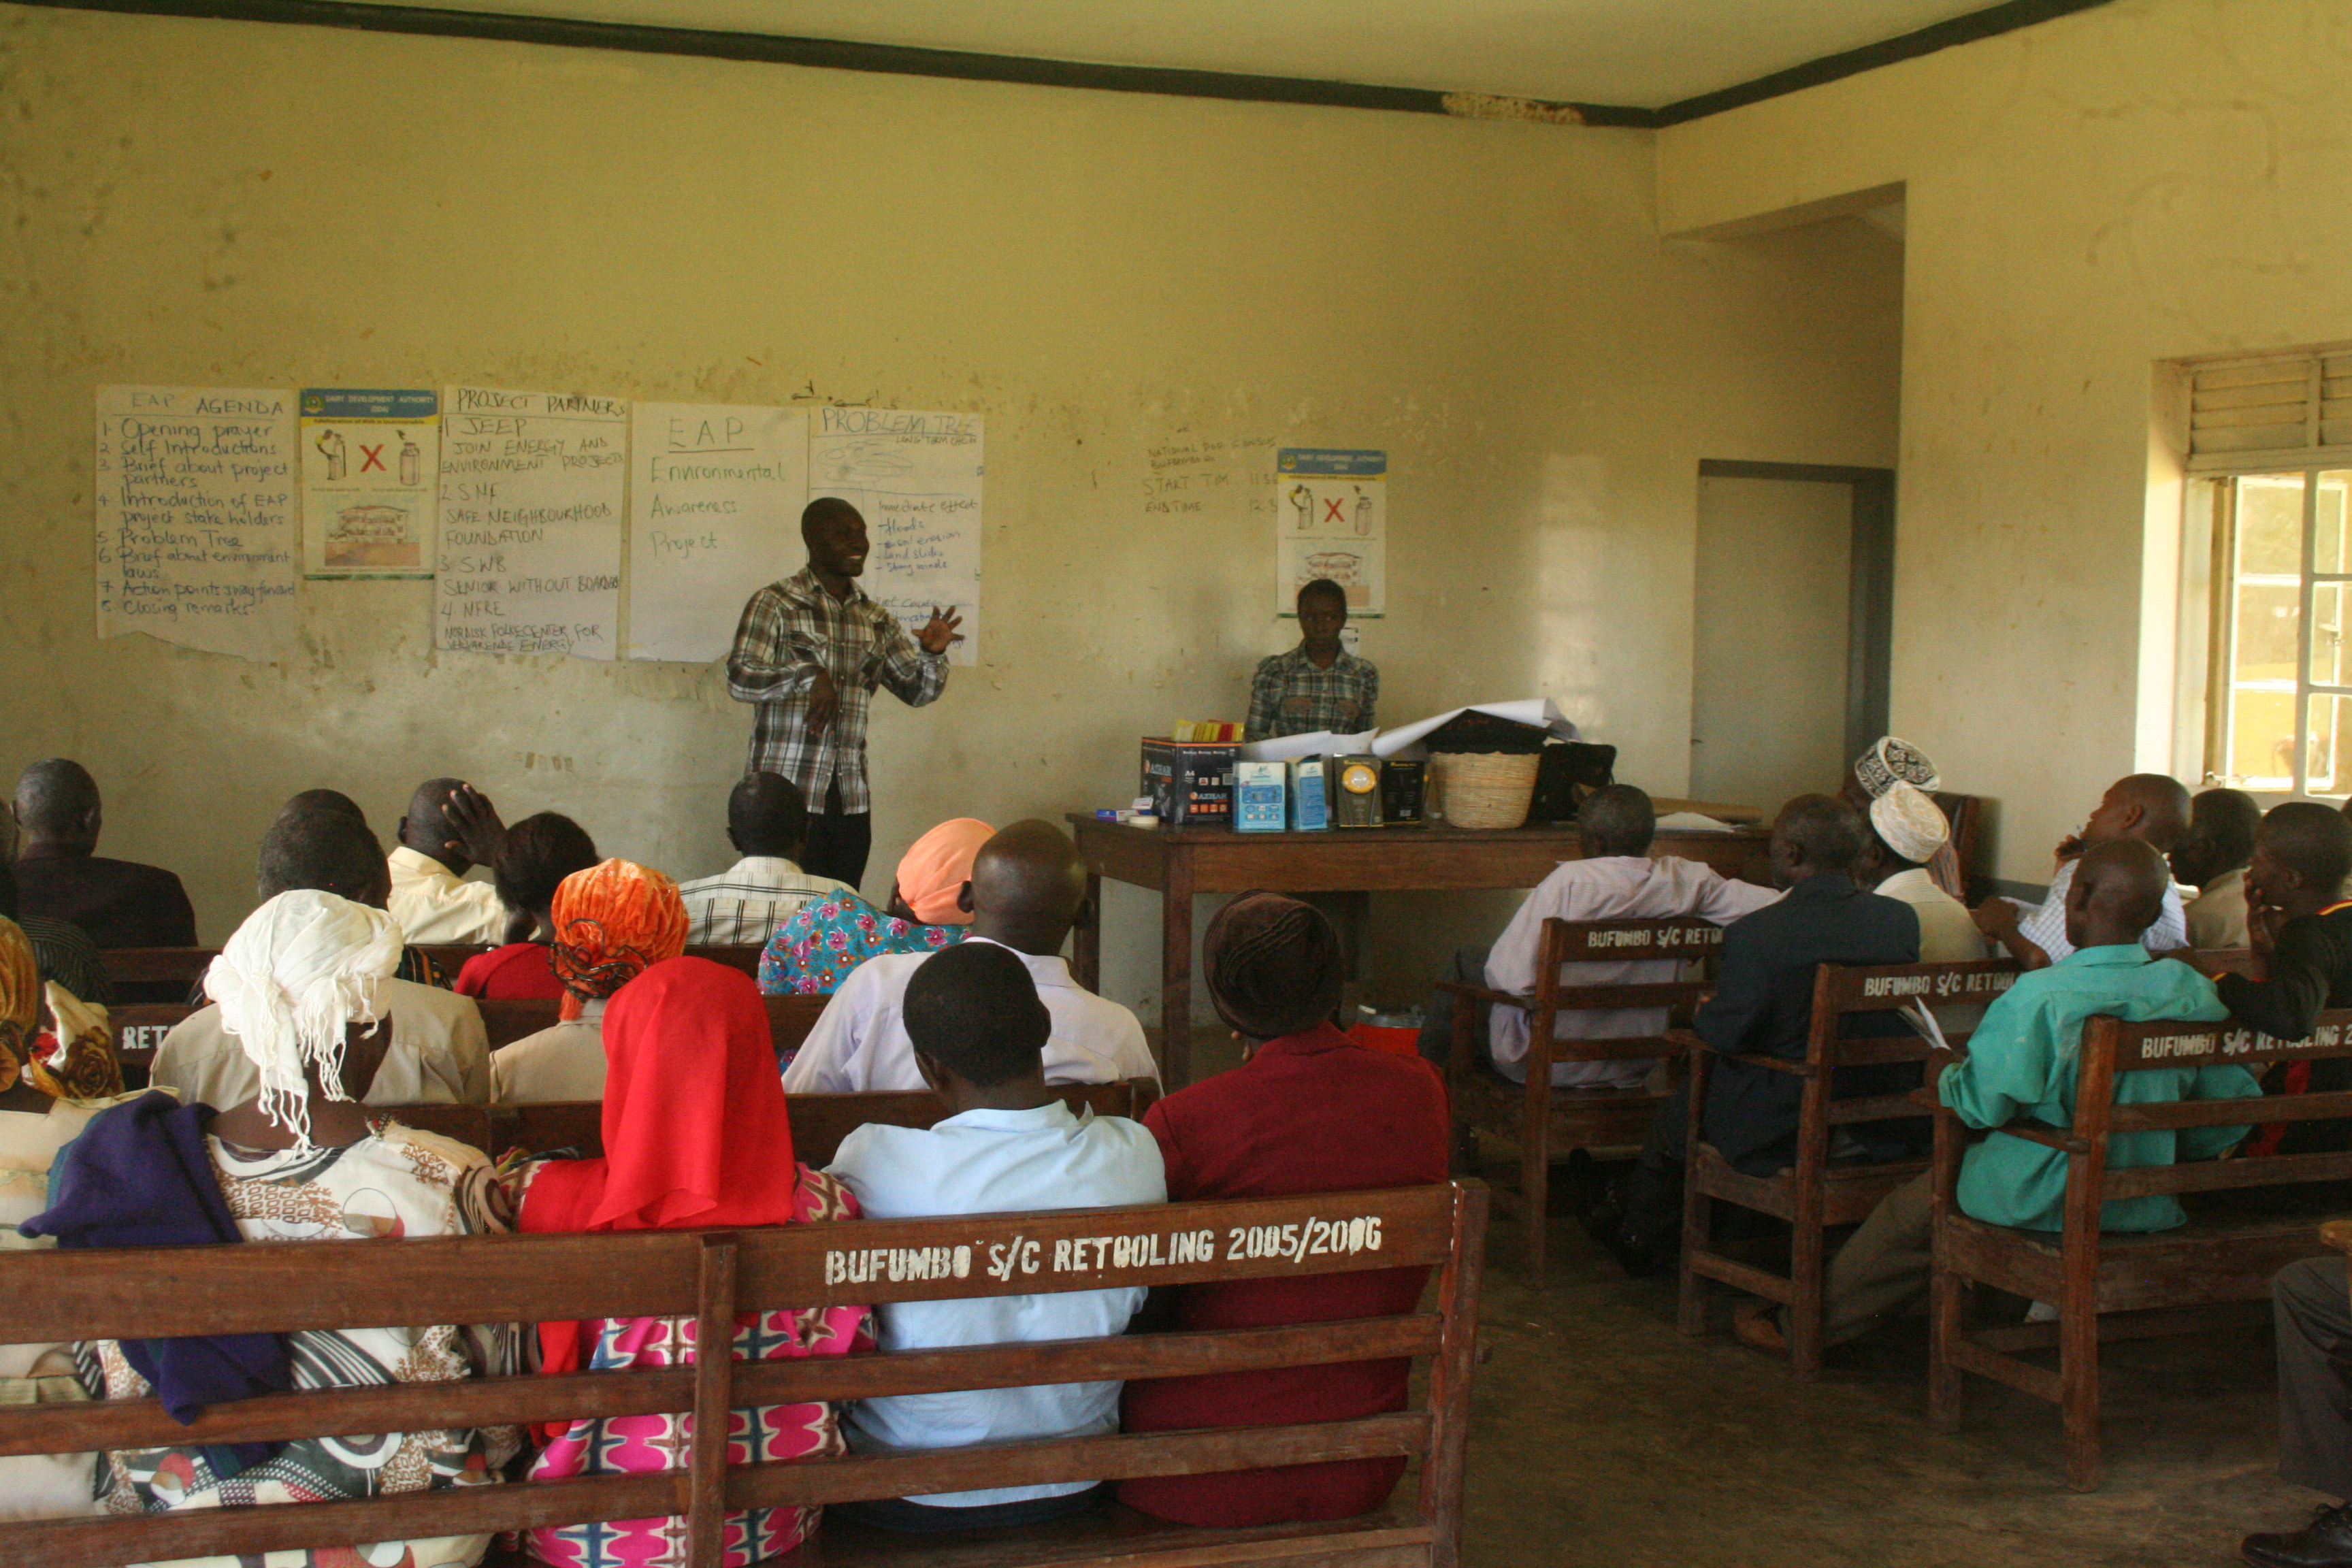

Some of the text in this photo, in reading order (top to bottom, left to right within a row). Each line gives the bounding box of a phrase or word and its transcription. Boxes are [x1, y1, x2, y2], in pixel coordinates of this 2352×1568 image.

[131, 392, 284, 415] EAP AGENDA
[458, 389, 625, 416] PROJECT PARTNERS
[121, 418, 201, 448] Opening
[213, 425, 272, 447] prayer
[460, 417, 527, 437] JEEP
[669, 416, 743, 448] EAP
[822, 408, 926, 436] PROBLEM
[121, 439, 157, 462] Self
[165, 440, 277, 455] Introductions
[504, 439, 565, 456] ENERGY
[580, 437, 608, 452] AND
[120, 457, 165, 475] Brief
[175, 456, 223, 474] about
[231, 459, 287, 482] project
[441, 459, 543, 474] ENVIRONMENT
[122, 473, 198, 494] partners
[120, 487, 225, 508] Introduction
[231, 493, 247, 514] of
[255, 494, 288, 506] EAP
[651, 494, 737, 519] Awareness
[122, 511, 175, 530] project
[447, 503, 612, 527] SAFE NEIGHBOURHOOD
[118, 527, 197, 547] Problem
[200, 529, 243, 547] Tree
[446, 528, 543, 549] FOUNDATION
[650, 530, 717, 559] Project
[116, 546, 161, 568] Brief
[167, 548, 208, 562] about
[122, 564, 159, 578] laws
[123, 581, 171, 596] Action
[174, 581, 220, 601] points
[509, 576, 572, 594] WITHOUT
[124, 599, 178, 621] Closing
[186, 598, 249, 615] remarks
[464, 601, 506, 619] NFRE
[574, 623, 604, 642] FOR
[520, 639, 575, 653] ENERGY
[1588, 929, 1651, 947] BUFUMBO
[1656, 926, 1680, 948] S/C
[1864, 975, 1931, 996] BUFUMBO
[1936, 971, 1962, 996] S/C
[2142, 1033, 2217, 1059] BUFUMBO
[2221, 1028, 2251, 1056] S/C
[825, 1215, 1382, 1286] BUFUMBO S/C RETOOLING 2005/2006
